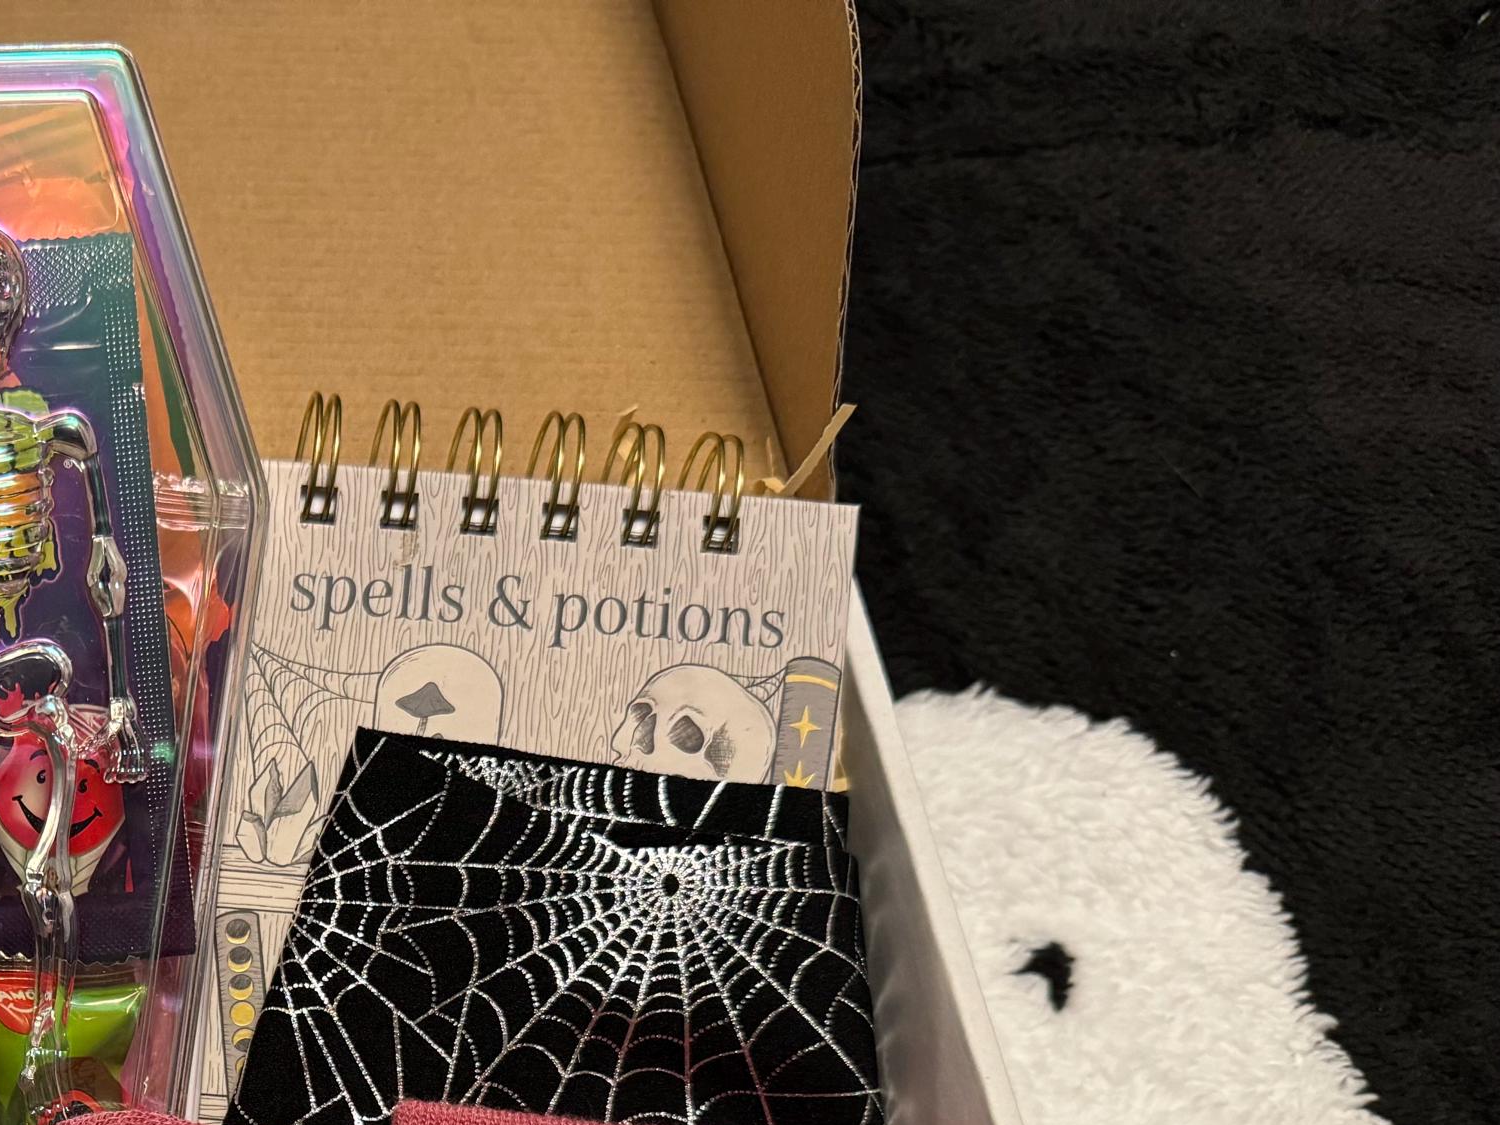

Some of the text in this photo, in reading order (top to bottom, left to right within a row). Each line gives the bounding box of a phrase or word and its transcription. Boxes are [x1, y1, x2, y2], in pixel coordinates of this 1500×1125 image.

[289, 566, 786, 648] spells & potions
